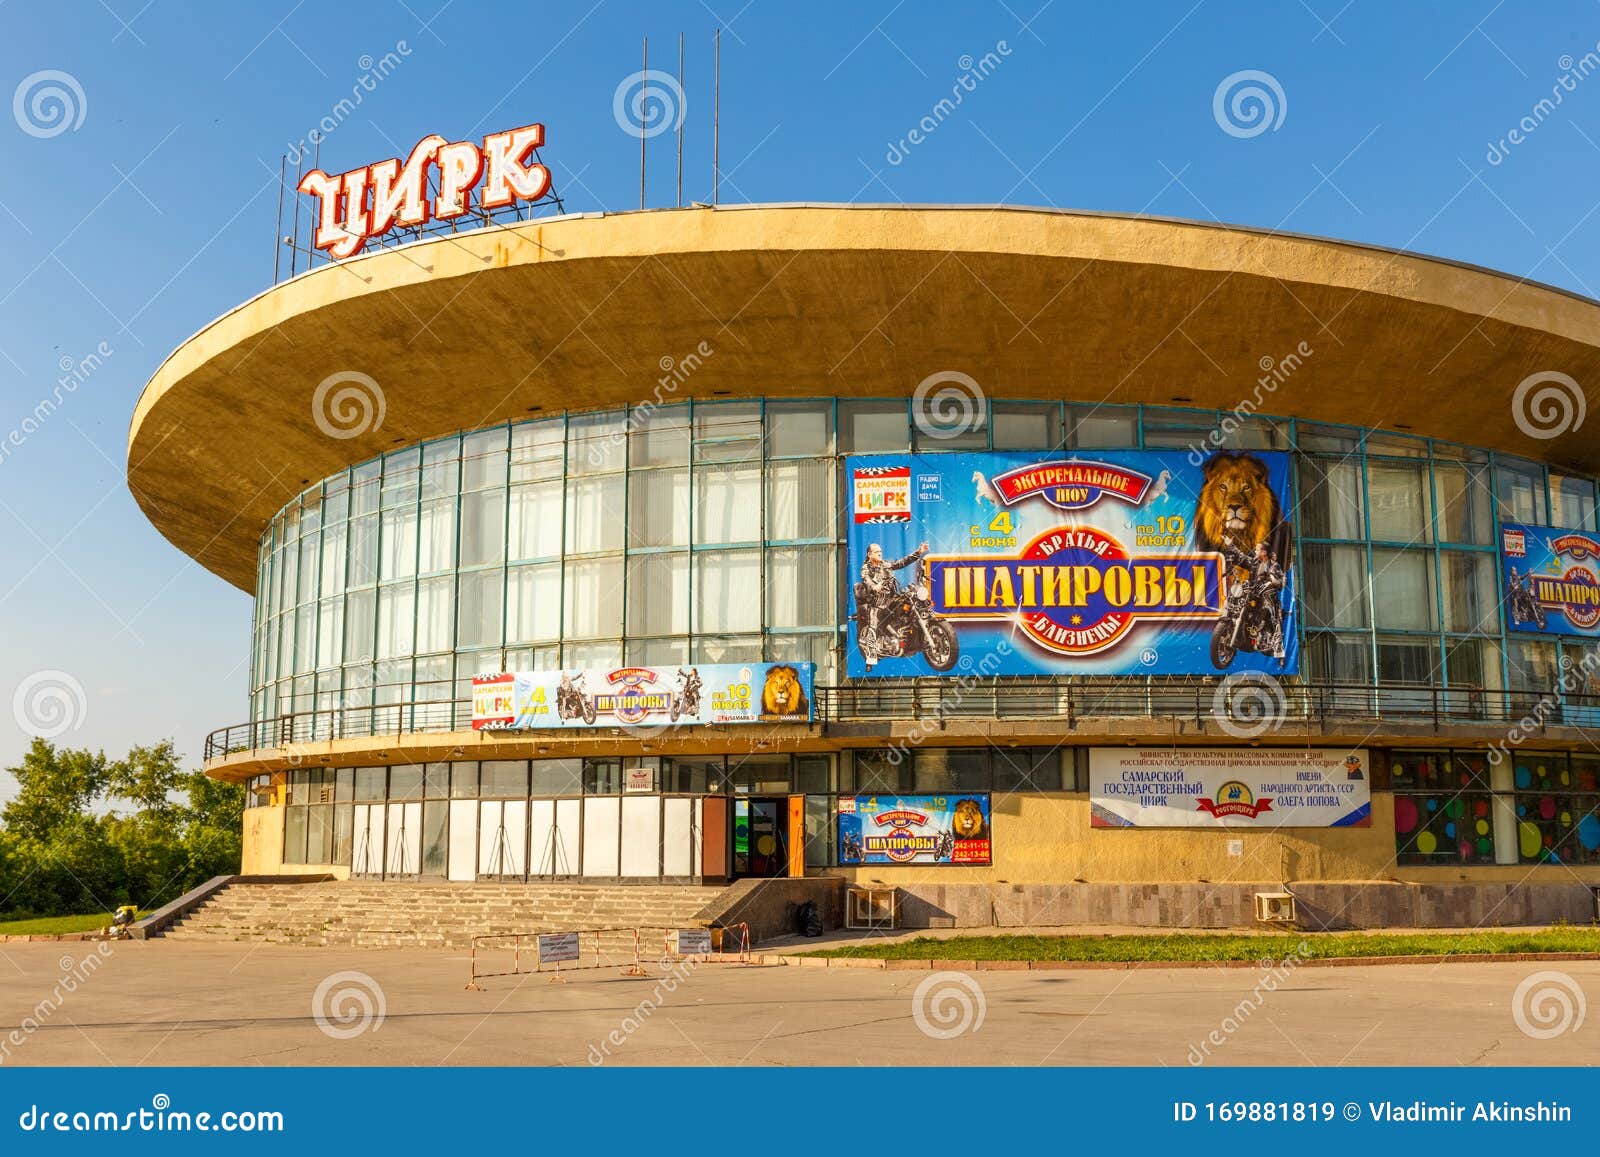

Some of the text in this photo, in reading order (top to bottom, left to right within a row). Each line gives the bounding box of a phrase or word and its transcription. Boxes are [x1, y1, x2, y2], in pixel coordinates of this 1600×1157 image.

[297, 123, 551, 259] ЦИРК
[856, 479, 908, 489] САМАРСКИЙ
[1012, 467, 1130, 492] ЭКСТРЕМАЛЬНОЕ
[858, 491, 907, 510] ЦИРК
[1056, 487, 1089, 503] ШОУ
[988, 511, 1013, 534] 4
[1155, 515, 1185, 535] 10
[1039, 529, 1110, 557] БРАТЬЯ
[943, 565, 1208, 608] ШАТИРОВЫ
[1538, 581, 1600, 606] ШАТИРО
[1033, 613, 1123, 647] БЛИЗНЕЦЫ
[531, 686, 546, 704] 4
[728, 683, 751, 700] 10
[475, 696, 513, 716] ЦИРК
[597, 695, 668, 710] ШАТИРОВЫ
[1233, 751, 1270, 759] МАССОВЫХ
[1122, 769, 1184, 782] САМАРСКИЙ
[1296, 772, 1322, 781] ИМЕНИ
[1103, 782, 1203, 796] ГОСУДАРСТВЕННЫЙ
[1260, 784, 1355, 793] НАРОДНОГО АРТИСТА СССР
[867, 797, 878, 808] 4
[1140, 796, 1167, 808] ЦИРК
[1277, 796, 1341, 807] ОЛЕГА ПОПОВА
[868, 837, 935, 850] ШАТИРОВЫ
